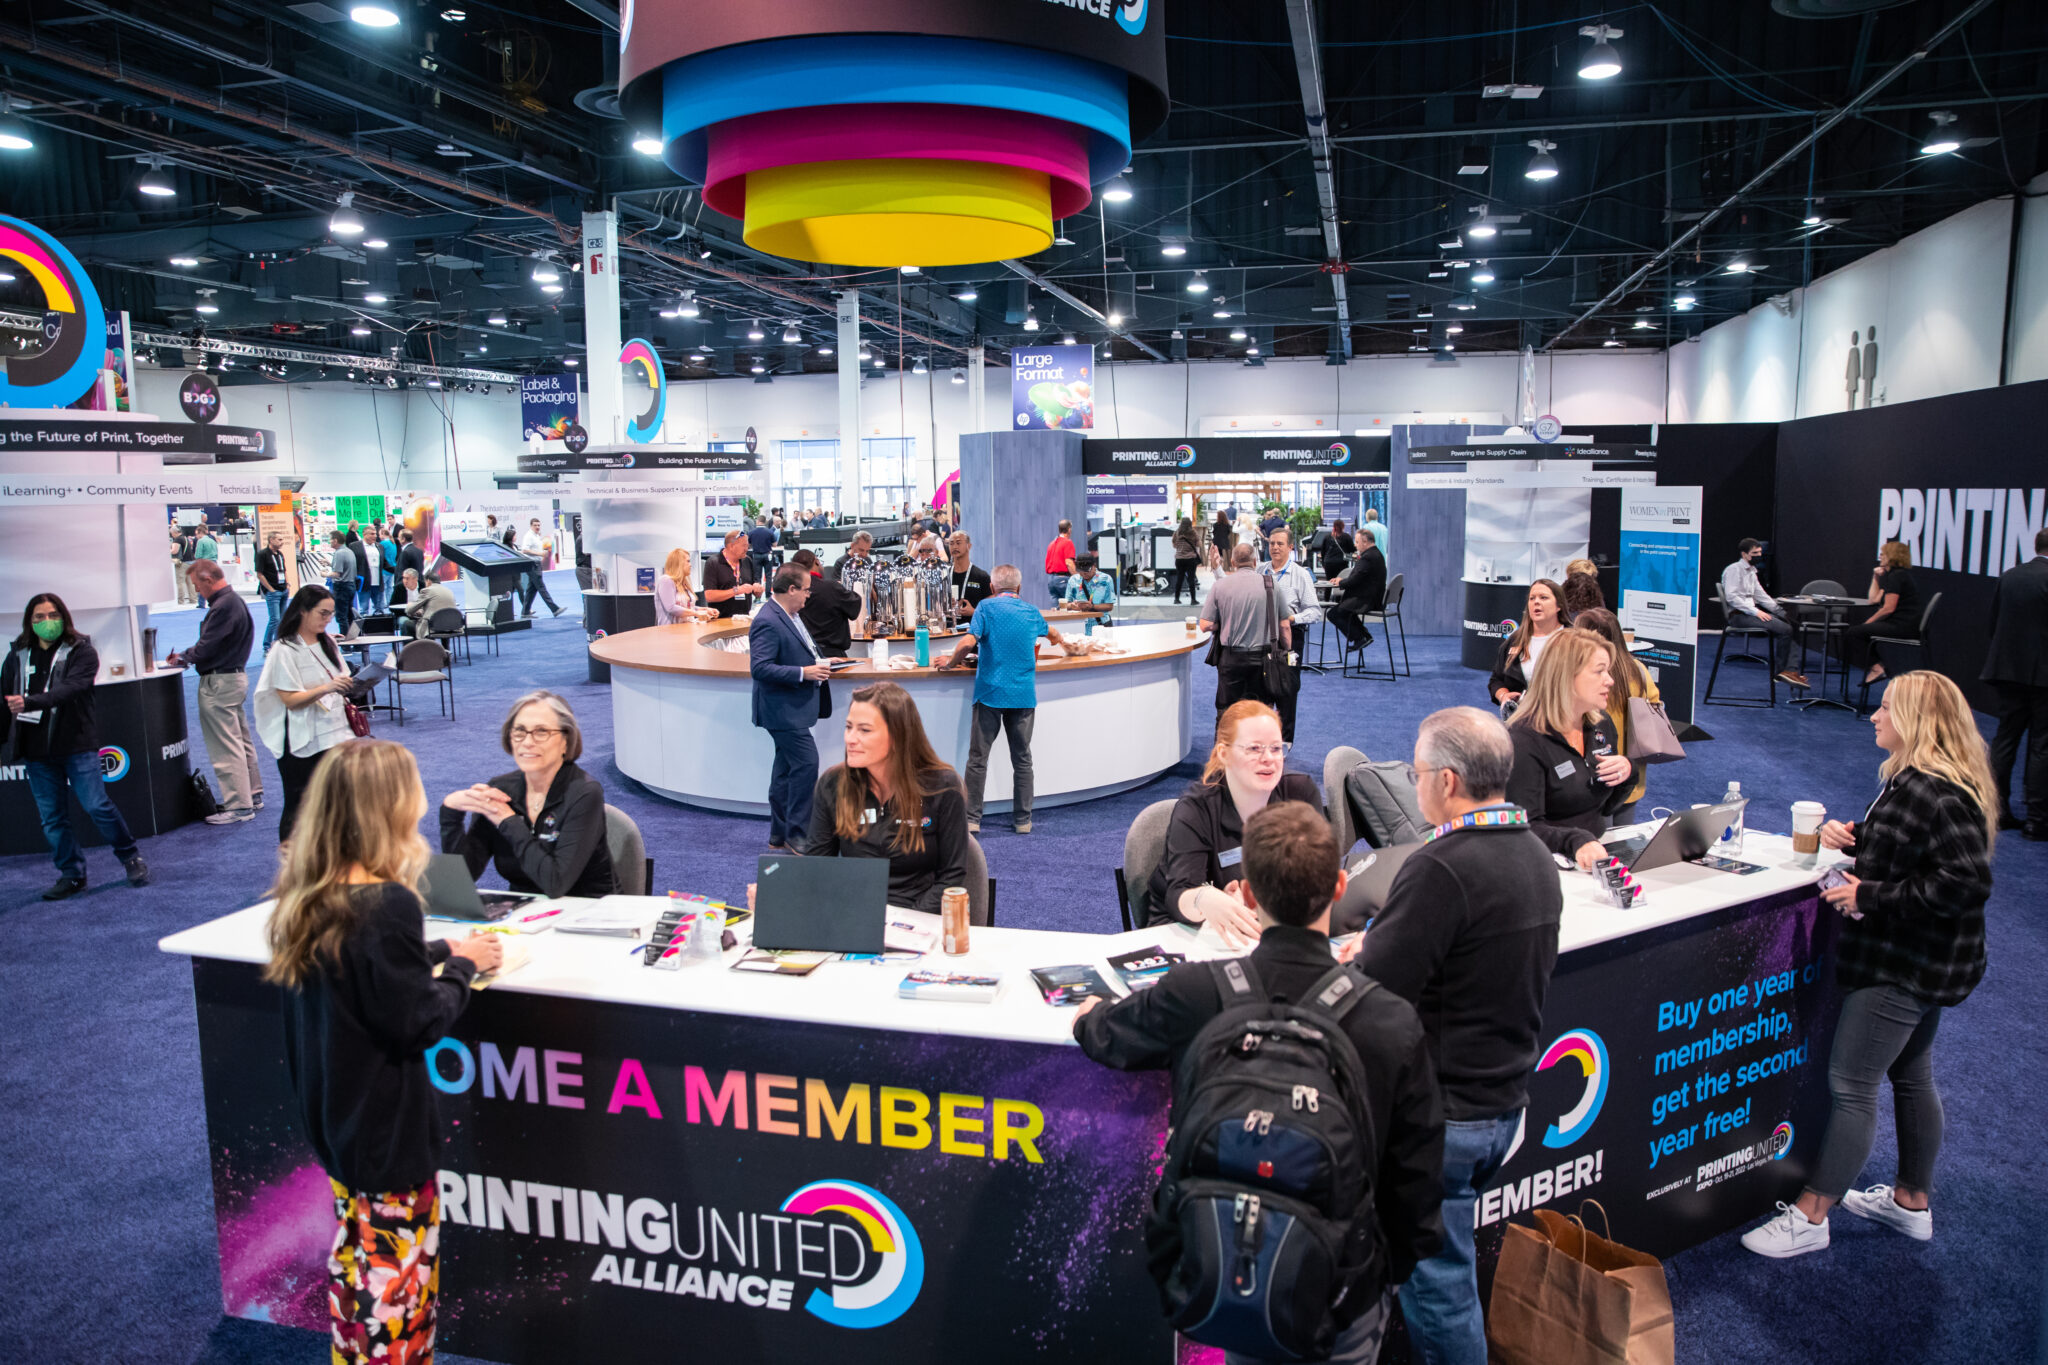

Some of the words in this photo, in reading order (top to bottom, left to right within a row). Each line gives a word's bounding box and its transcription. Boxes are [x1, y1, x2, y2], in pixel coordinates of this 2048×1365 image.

[1015, 352, 1054, 368] Large
[1015, 366, 1065, 381] Format
[521, 378, 550, 390] Label
[551, 377, 561, 390] &
[522, 390, 577, 405] Packaging
[10, 431, 33, 442] the
[38, 431, 81, 442] Future
[84, 432, 98, 442] of
[101, 432, 133, 444] Print,
[136, 432, 184, 445] Together
[1263, 449, 1343, 460] PRINTINGUNITED
[3, 485, 73, 498] iLearning+
[87, 485, 156, 498] Community
[159, 484, 194, 496] Events
[219, 485, 250, 495] Technical
[650, 486, 675, 494] Support
[1323, 482, 1354, 491] Designed
[1354, 482, 1364, 490] for
[1364, 482, 1390, 490] operato
[369, 496, 380, 506] Up
[369, 508, 385, 518] Out
[1629, 505, 1659, 516] WOMEN
[1667, 507, 1691, 517] PRINT
[1877, 488, 2048, 577] PRINTIN
[1657, 998, 1703, 1032] Buy
[1707, 988, 1749, 1016] one
[1753, 970, 1798, 1007] year
[1653, 1007, 1793, 1076] membership,
[1651, 1085, 1690, 1126] get
[1695, 1067, 1732, 1095] the
[1735, 1041, 1808, 1088] second
[424, 1036, 586, 1111] OME
[606, 1059, 663, 1120] A
[684, 1066, 1046, 1164] MEMBER
[1649, 1123, 1699, 1169] year
[1703, 1097, 1751, 1140] free!
[1474, 1149, 1604, 1229] EMBER!
[1646, 1180, 1684, 1200] EXCLUSIVELY
[1683, 1175, 1692, 1185] AT
[1696, 1179, 1713, 1192] EXPO
[437, 1169, 866, 1283] RINTINGUNITED
[591, 1254, 795, 1312] ALLIANCE
